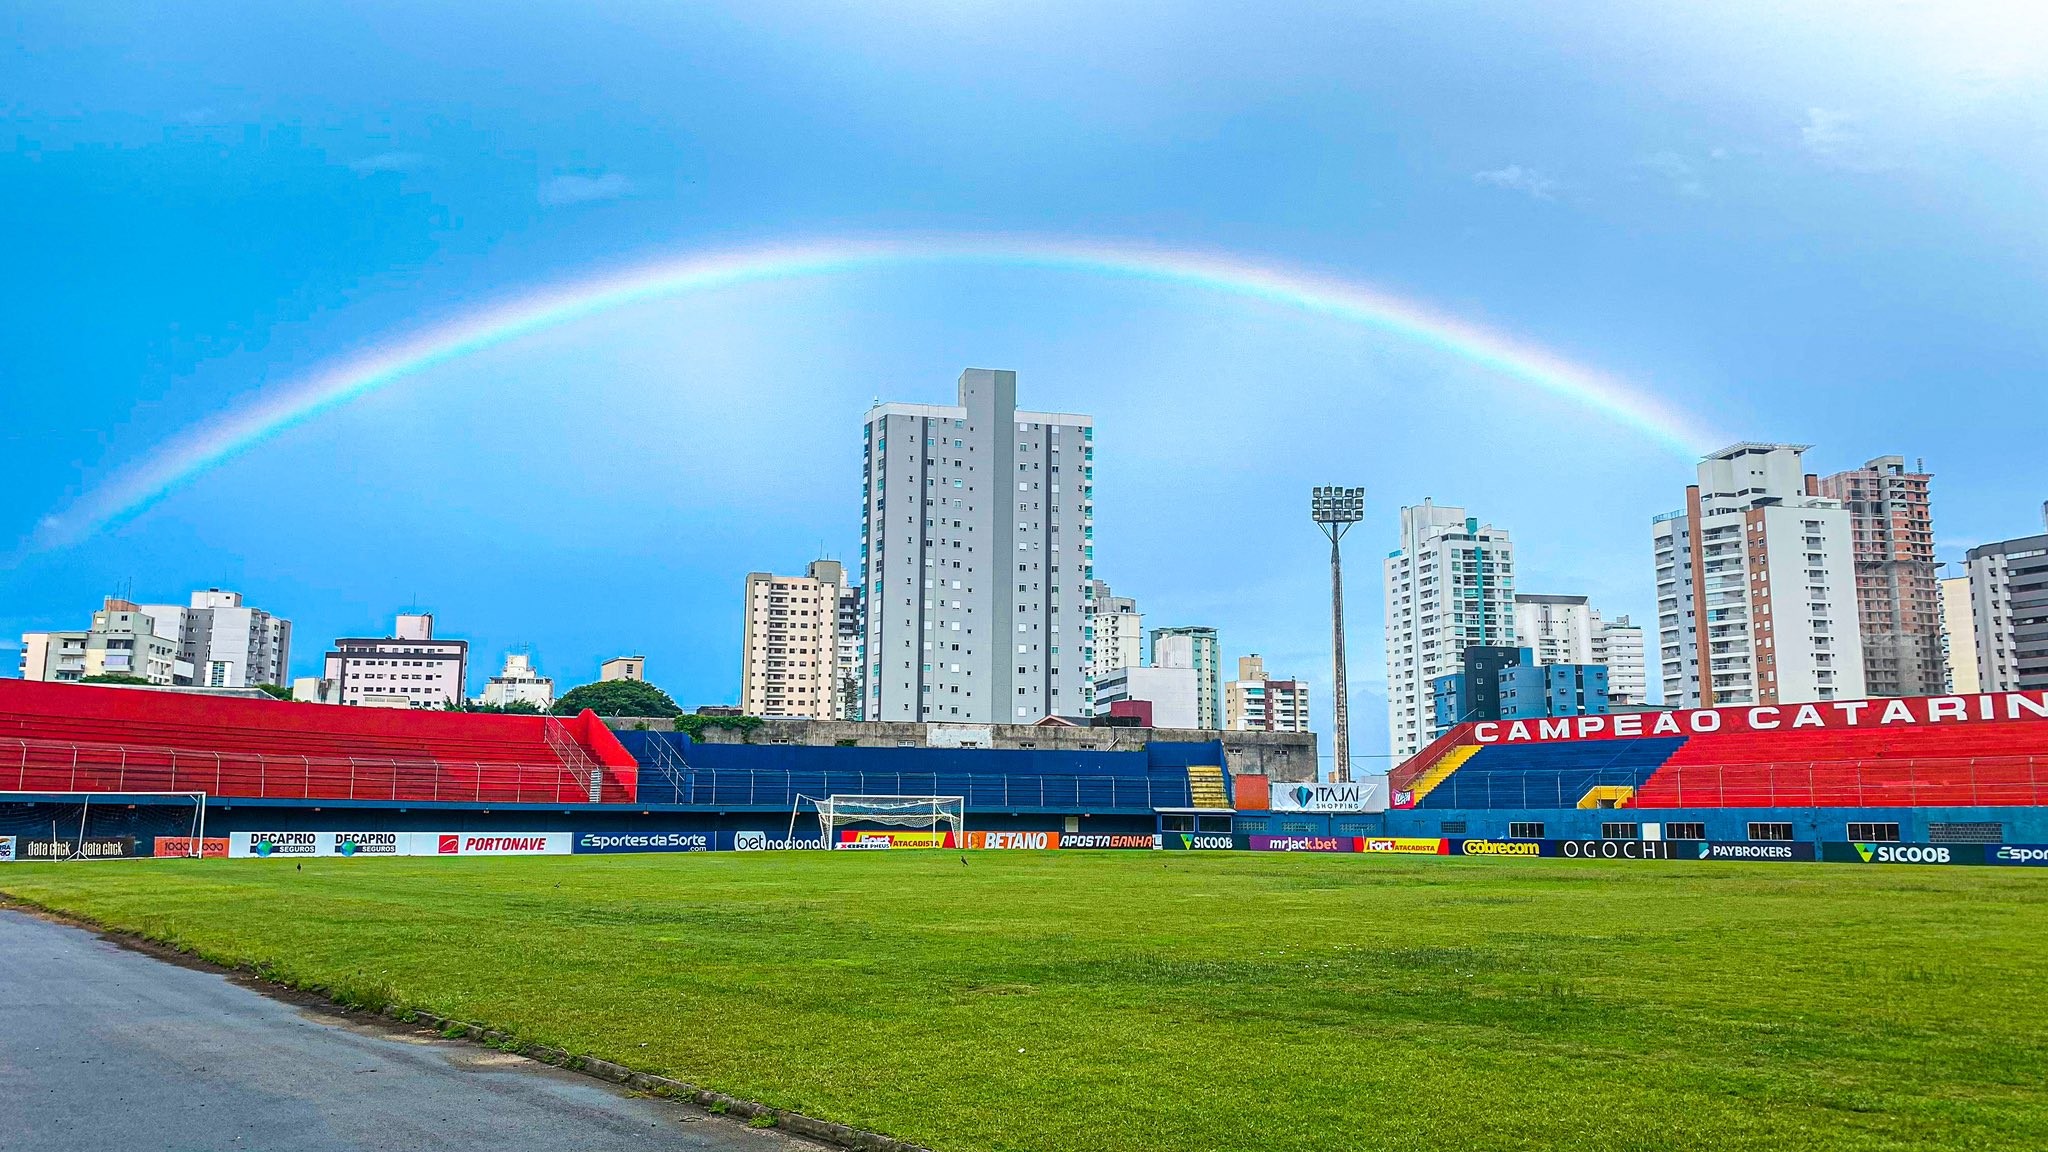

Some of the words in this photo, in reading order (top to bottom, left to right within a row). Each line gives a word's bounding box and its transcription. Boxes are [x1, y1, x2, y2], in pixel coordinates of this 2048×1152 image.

[1475, 710, 1720, 742] CAMPEÃO
[250, 833, 316, 844] DECAPRIO
[335, 833, 396, 844] DECAPRIO
[465, 837, 547, 851] PORTONAVE
[984, 832, 1048, 849] BETANO
[1194, 836, 1233, 849] SICOOB
[1369, 840, 1393, 851] Fort
[27, 841, 49, 856] data
[82, 841, 102, 856] data
[279, 845, 315, 853] SEGUROS
[1467, 840, 1540, 855] cobrecom
[1564, 841, 1667, 859] OGOCHI
[1713, 845, 1792, 857] PAYBROKERS
[1878, 847, 1950, 863] SICOOB
